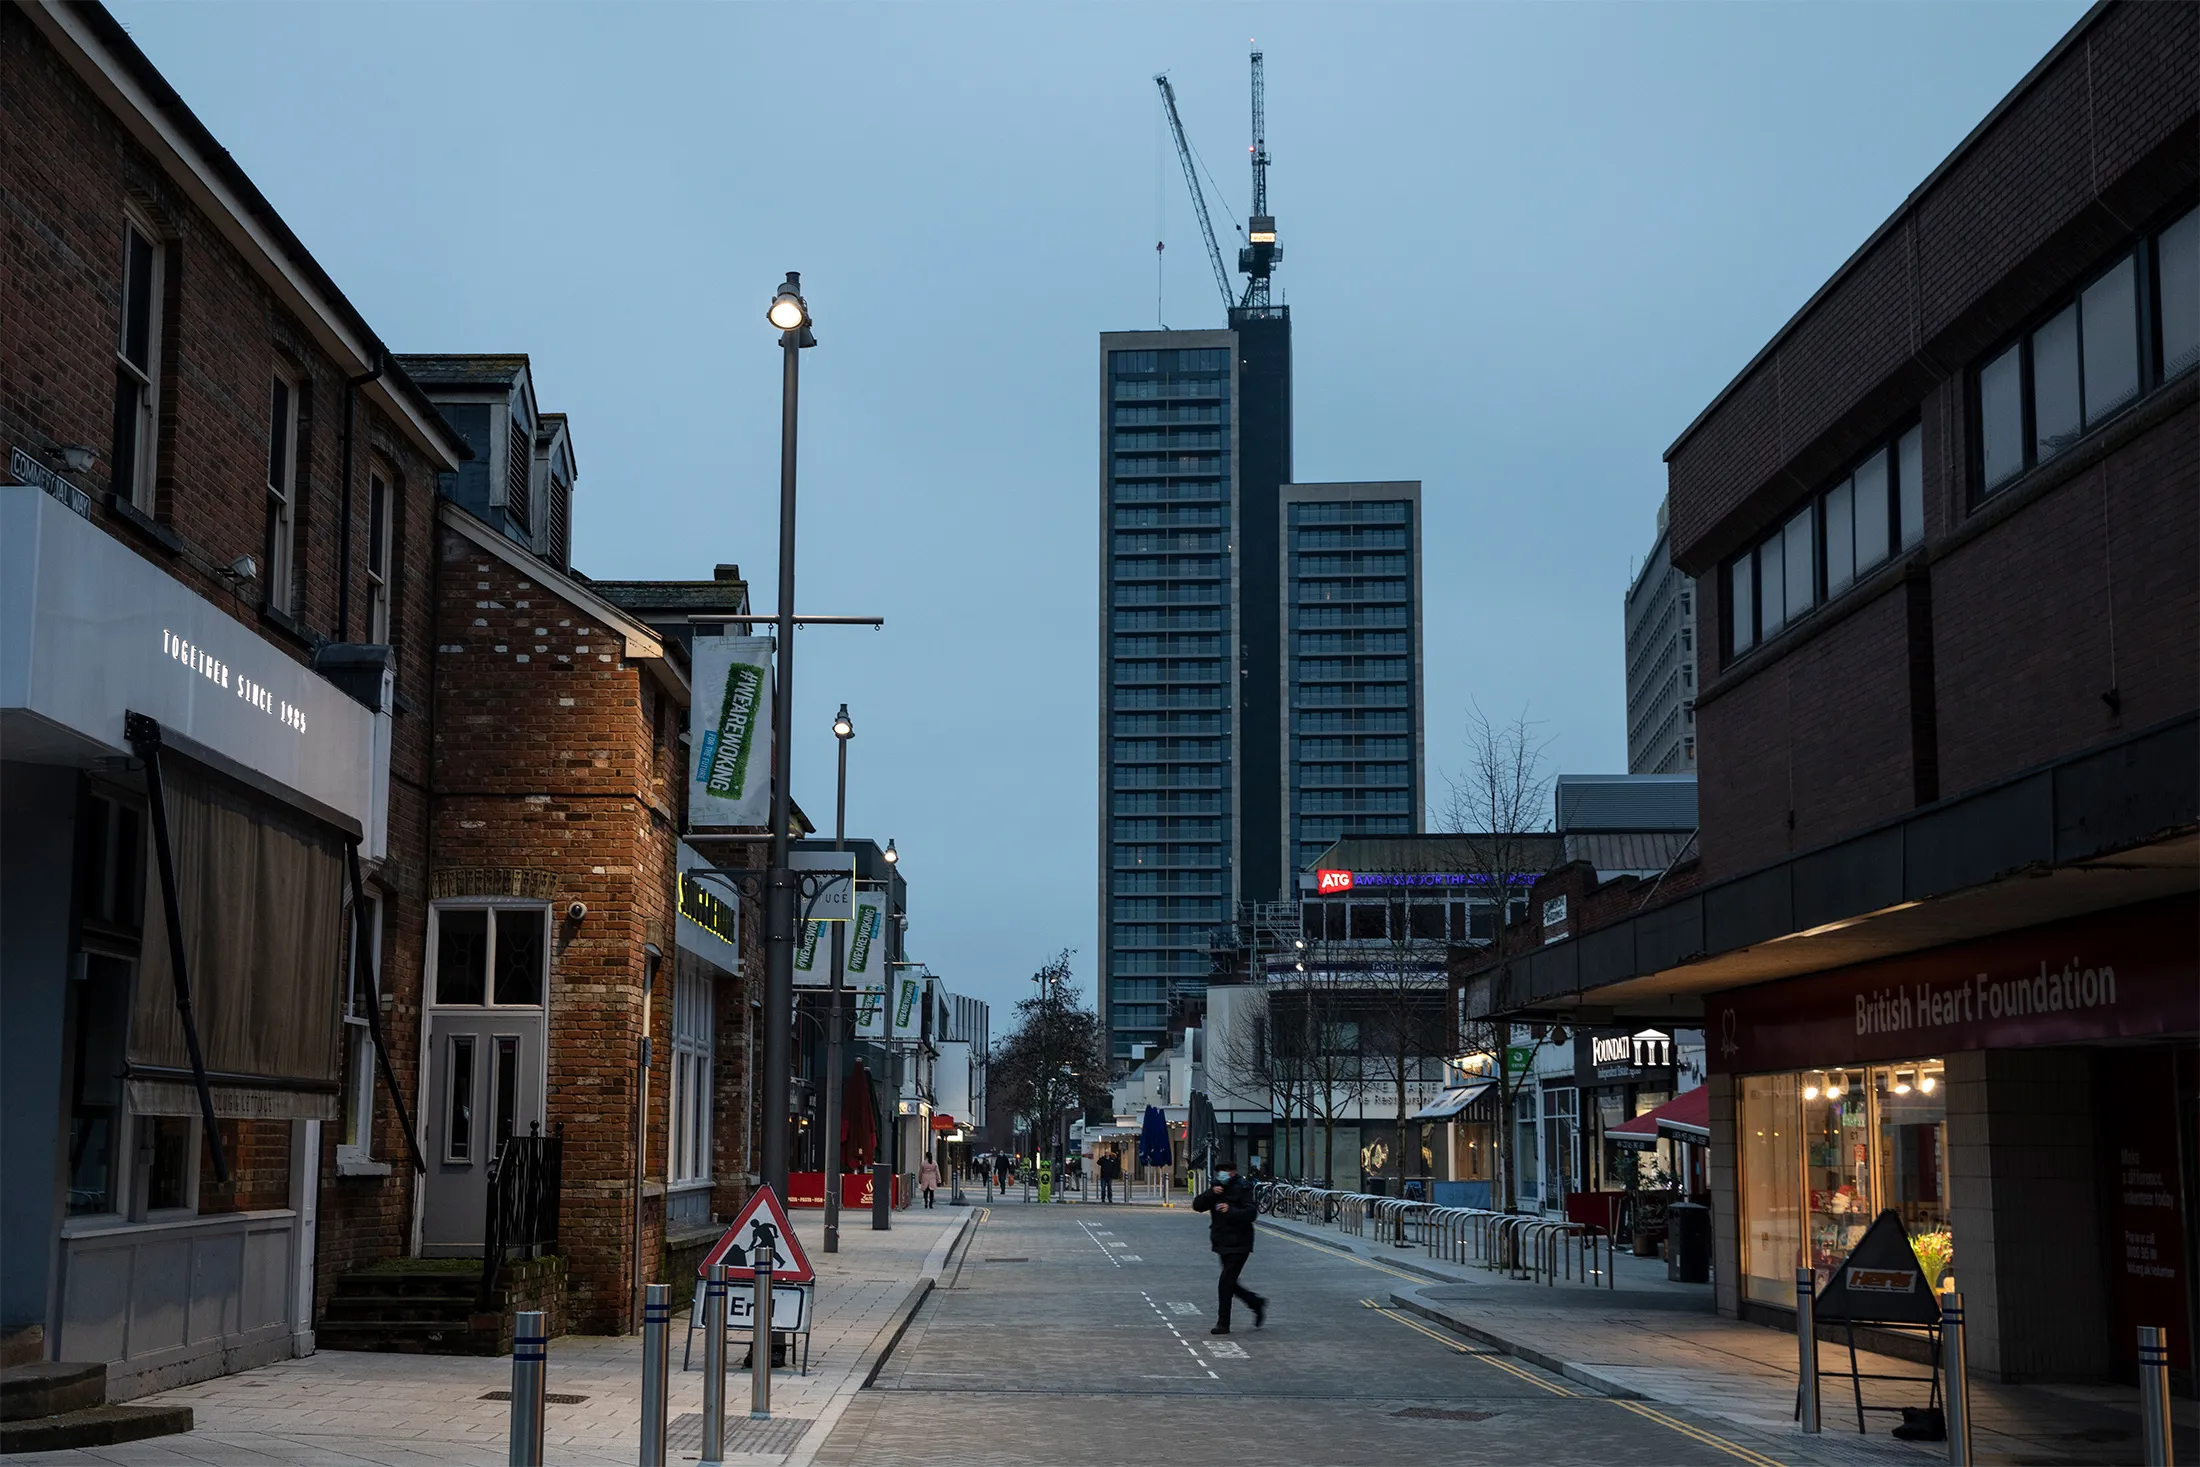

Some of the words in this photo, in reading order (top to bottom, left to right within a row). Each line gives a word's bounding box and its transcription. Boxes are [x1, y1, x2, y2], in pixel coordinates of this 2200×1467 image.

[72, 489, 88, 517] WAY
[163, 629, 229, 689] TOGETHER
[237, 674, 273, 715] SINCE
[710, 670, 759, 791] #WEAREWOKING
[1321, 873, 1349, 888] ATG
[1355, 873, 1442, 886] AMBASSADOR
[852, 908, 875, 970] #WEAREWOKING
[1855, 988, 1912, 1036] British
[1916, 982, 1972, 1028] Heart
[1976, 955, 2117, 1021] Foundation
